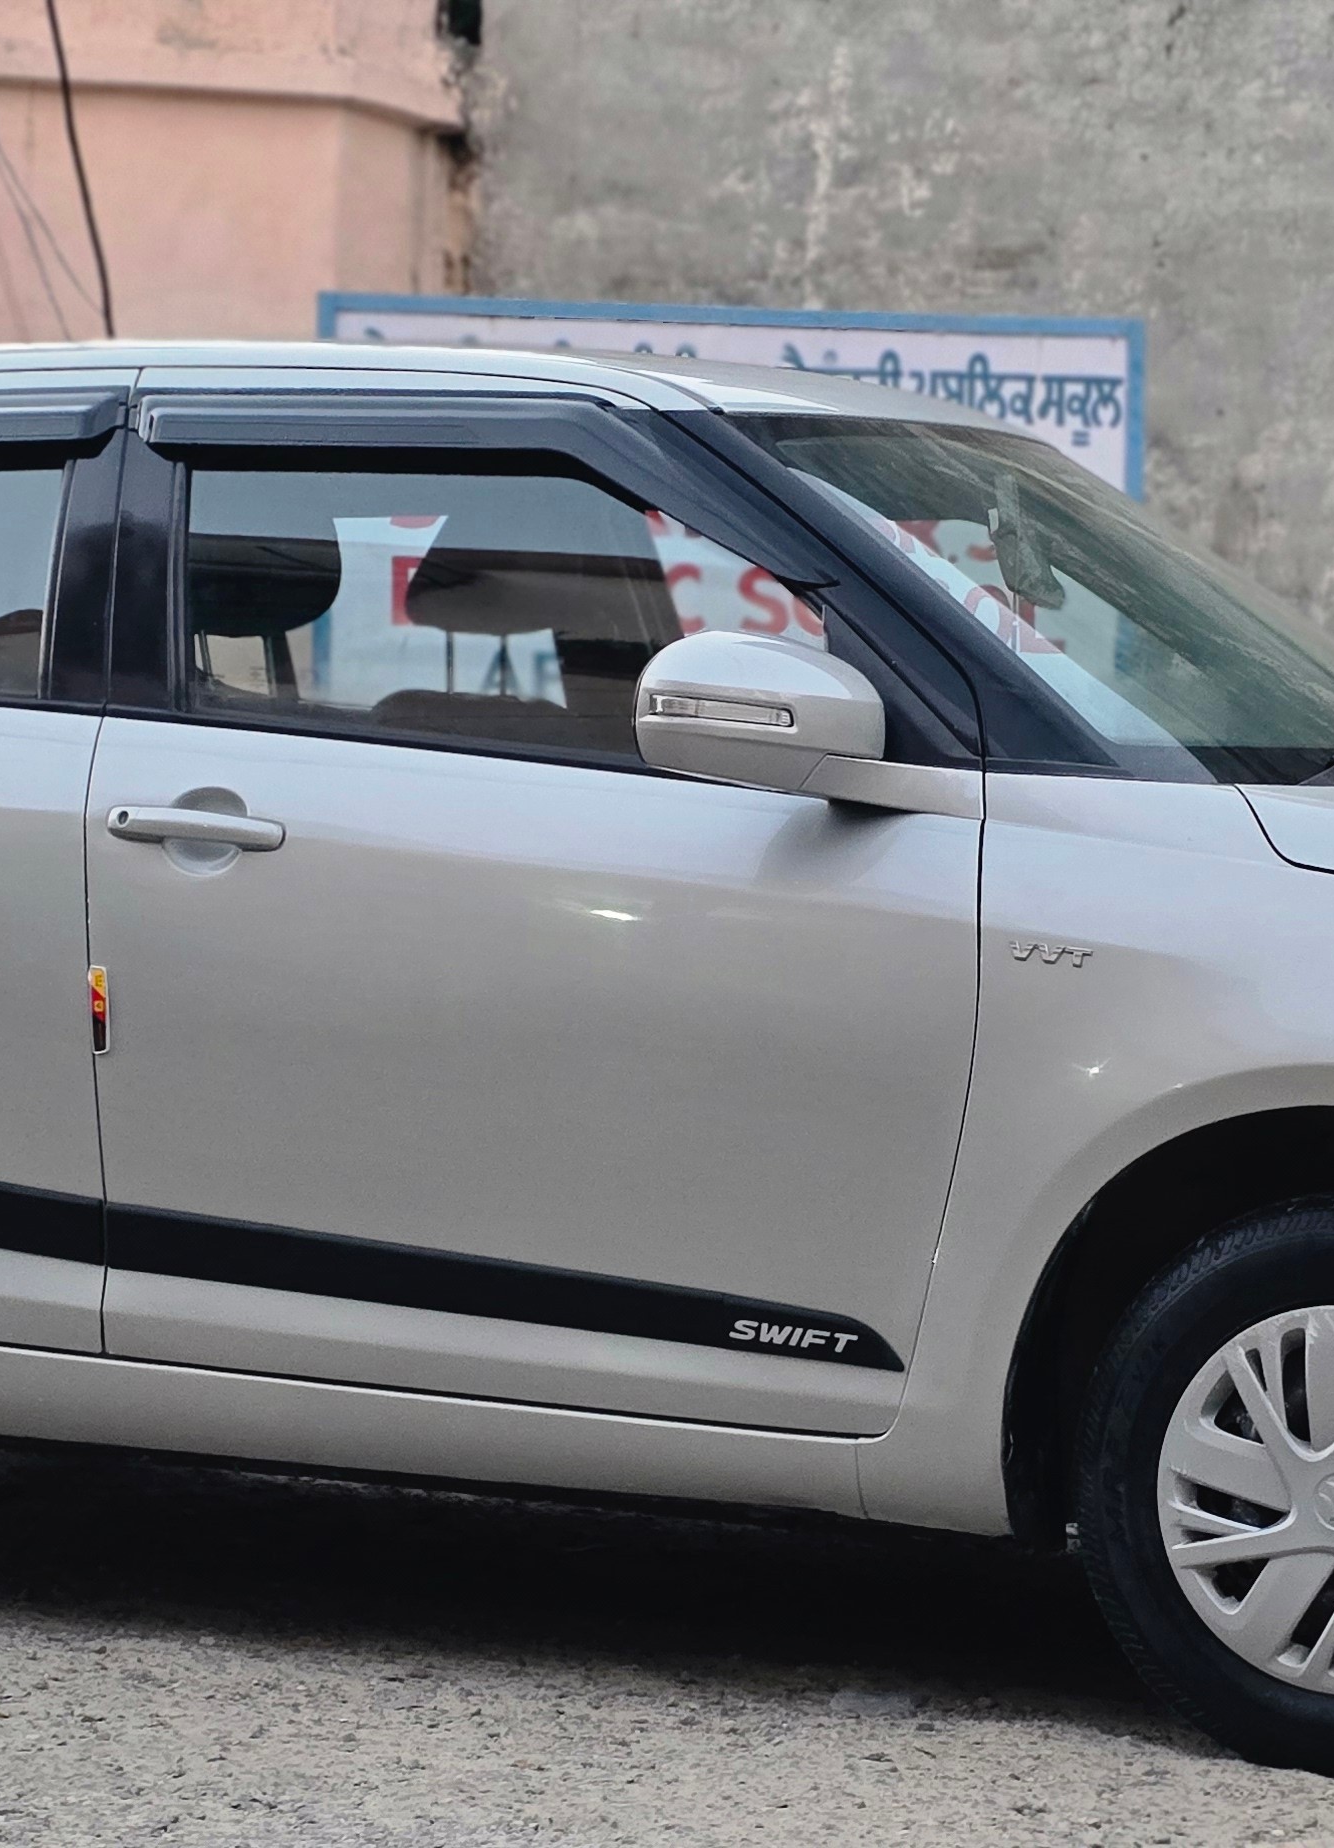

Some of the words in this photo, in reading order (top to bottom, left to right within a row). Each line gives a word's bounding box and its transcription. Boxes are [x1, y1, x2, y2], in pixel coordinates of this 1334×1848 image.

[1037, 374, 1124, 447] ਸਕੂਲ
[1009, 940, 1093, 968] VVT
[728, 1319, 859, 1354] SWIFT
